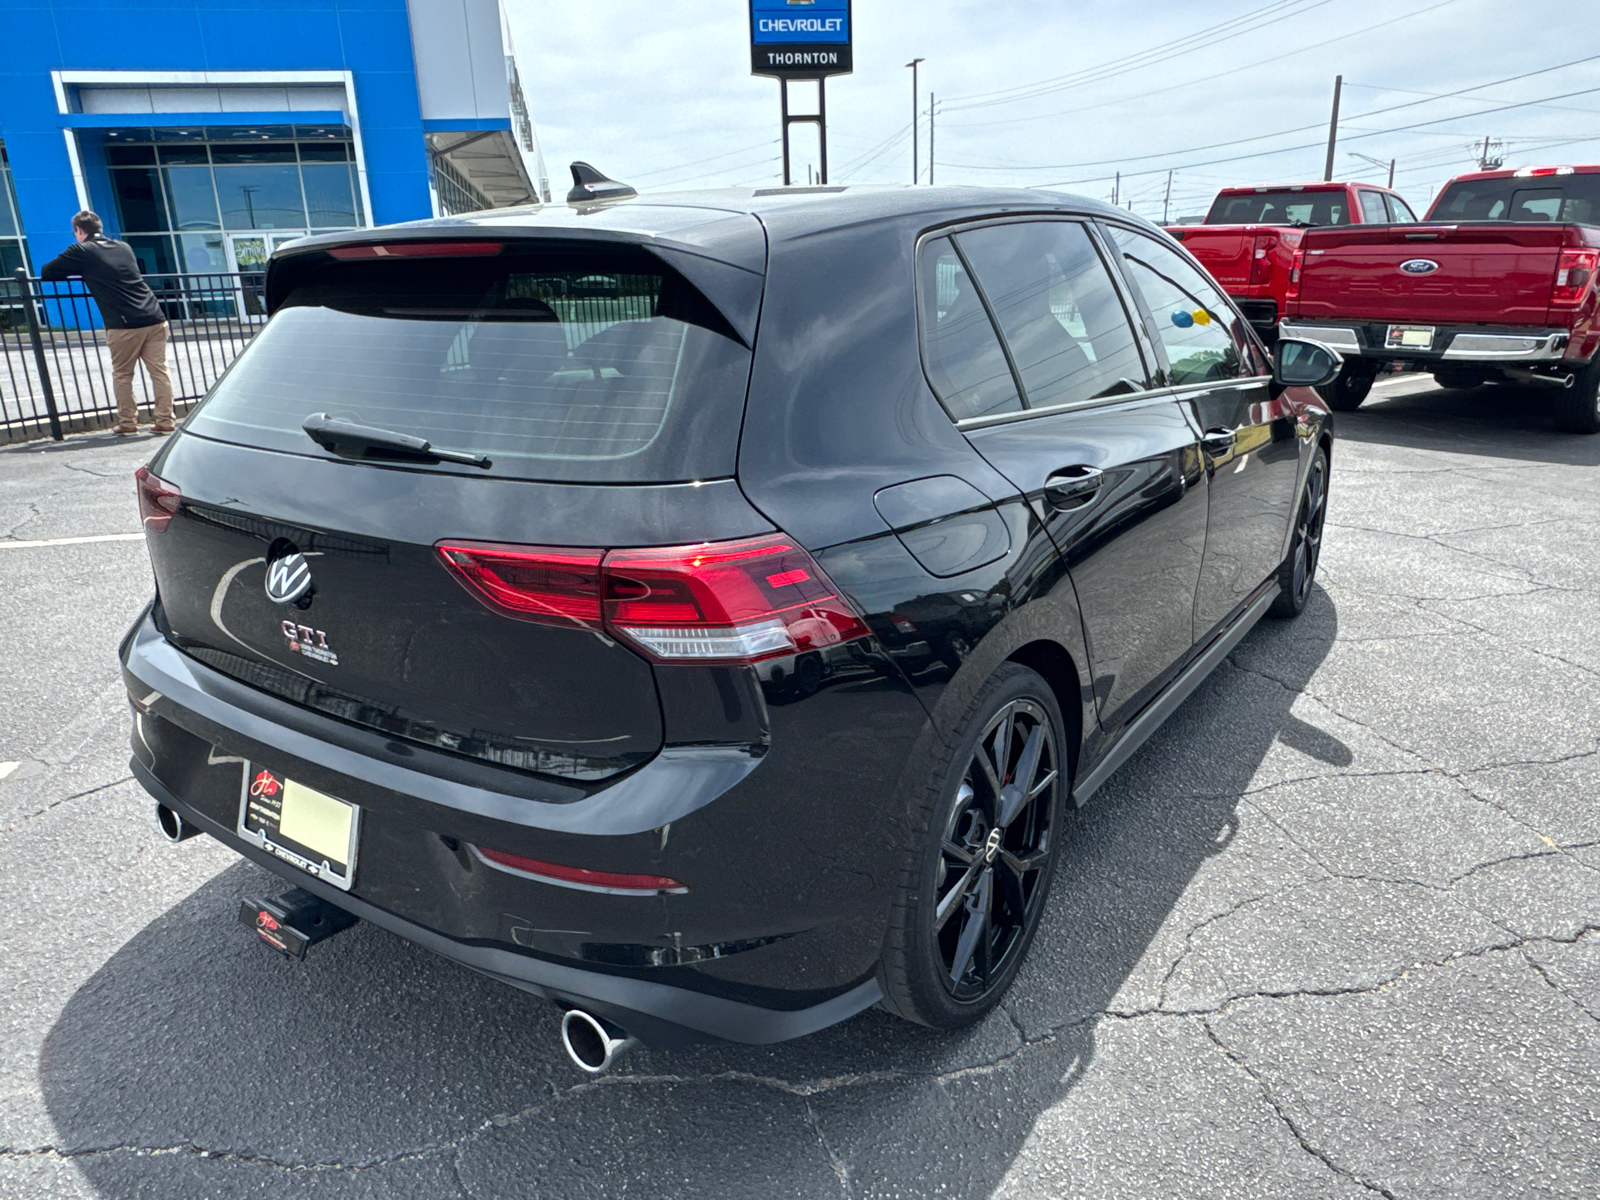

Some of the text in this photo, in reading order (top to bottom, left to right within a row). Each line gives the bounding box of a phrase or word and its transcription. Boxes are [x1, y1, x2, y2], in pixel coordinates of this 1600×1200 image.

[759, 18, 843, 32] CHEVROLET
[767, 52, 838, 65] THORNTON
[281, 620, 329, 650] GTI
